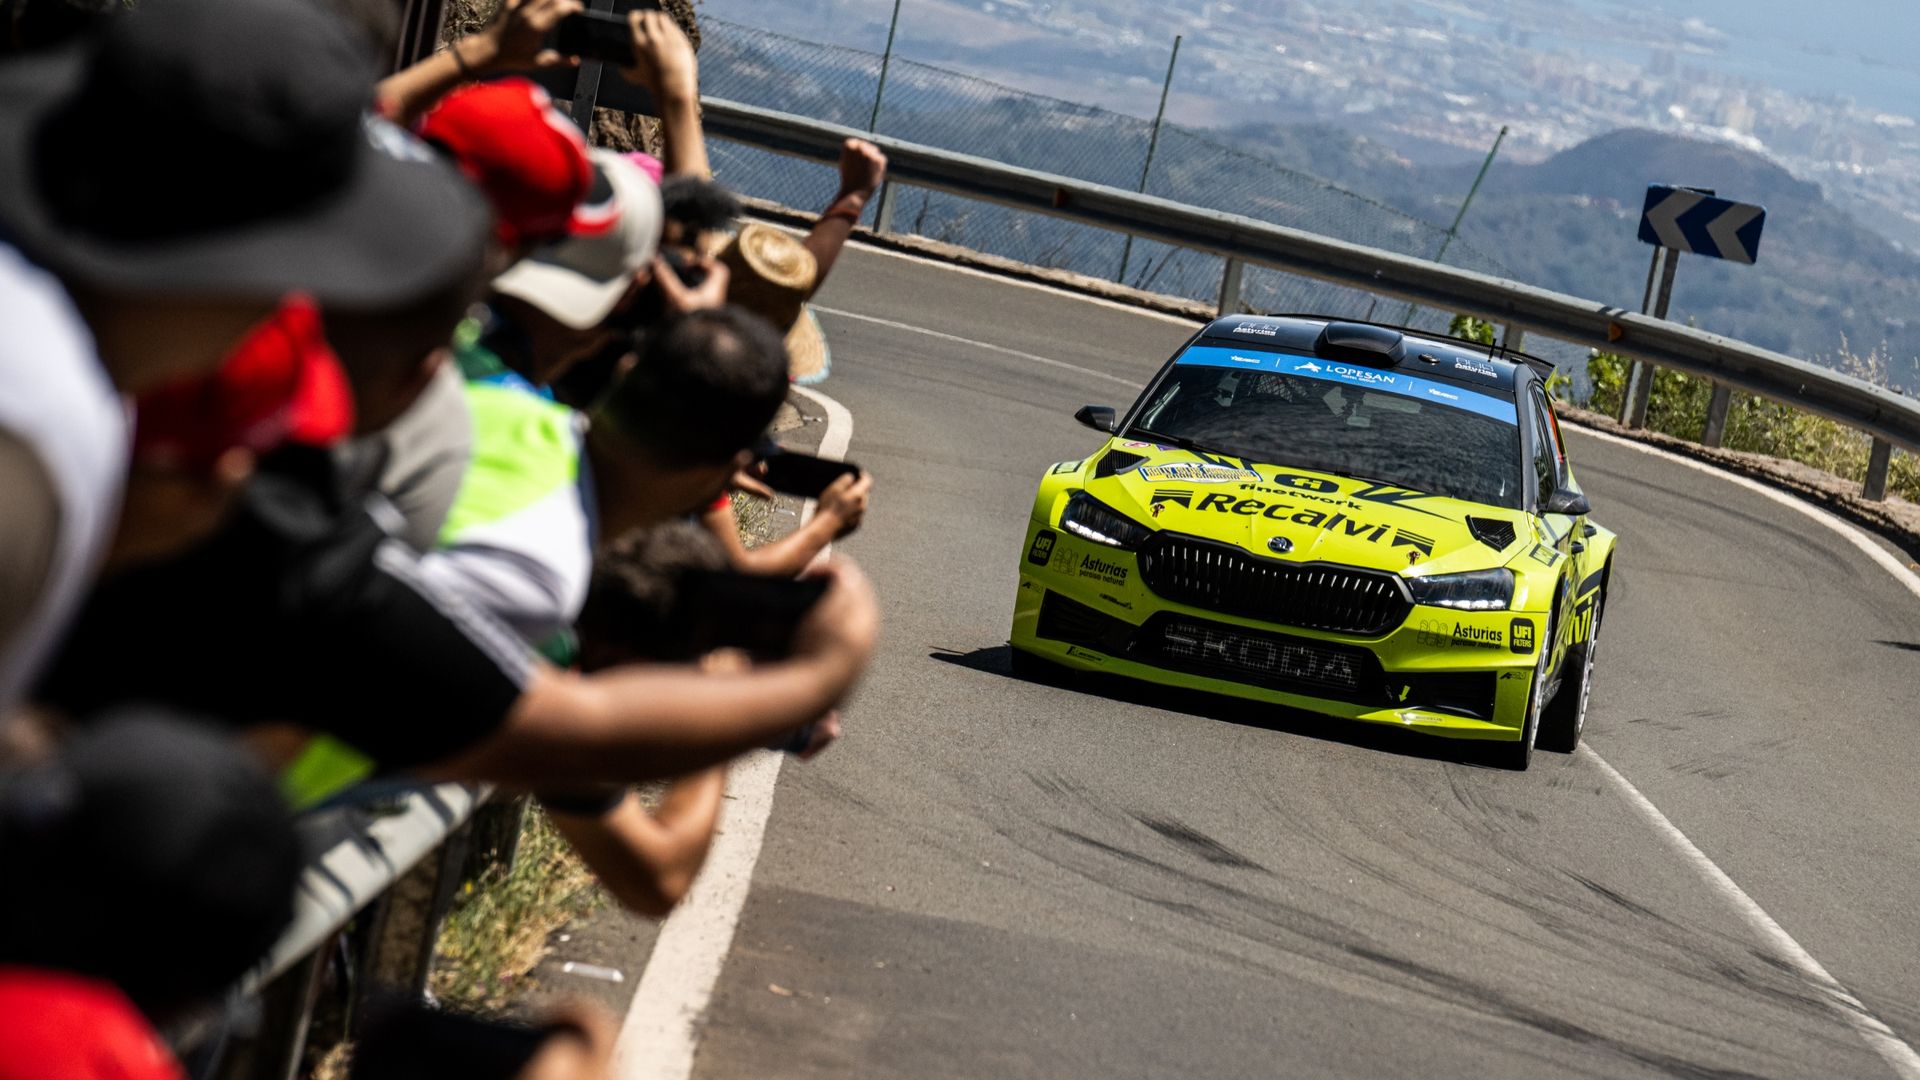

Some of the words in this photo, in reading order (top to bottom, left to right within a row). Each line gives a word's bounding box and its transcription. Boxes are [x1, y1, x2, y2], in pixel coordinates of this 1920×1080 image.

[1325, 364, 1396, 385] LOPESAN
[1238, 483, 1364, 511] finetwork
[1195, 492, 1392, 544] Recalvi
[1035, 536, 1052, 551] UFI
[1080, 553, 1129, 579] Asturias
[1452, 621, 1503, 642] Asturias
[1513, 624, 1533, 640] UFI
[1513, 638, 1532, 648] FILTERS
